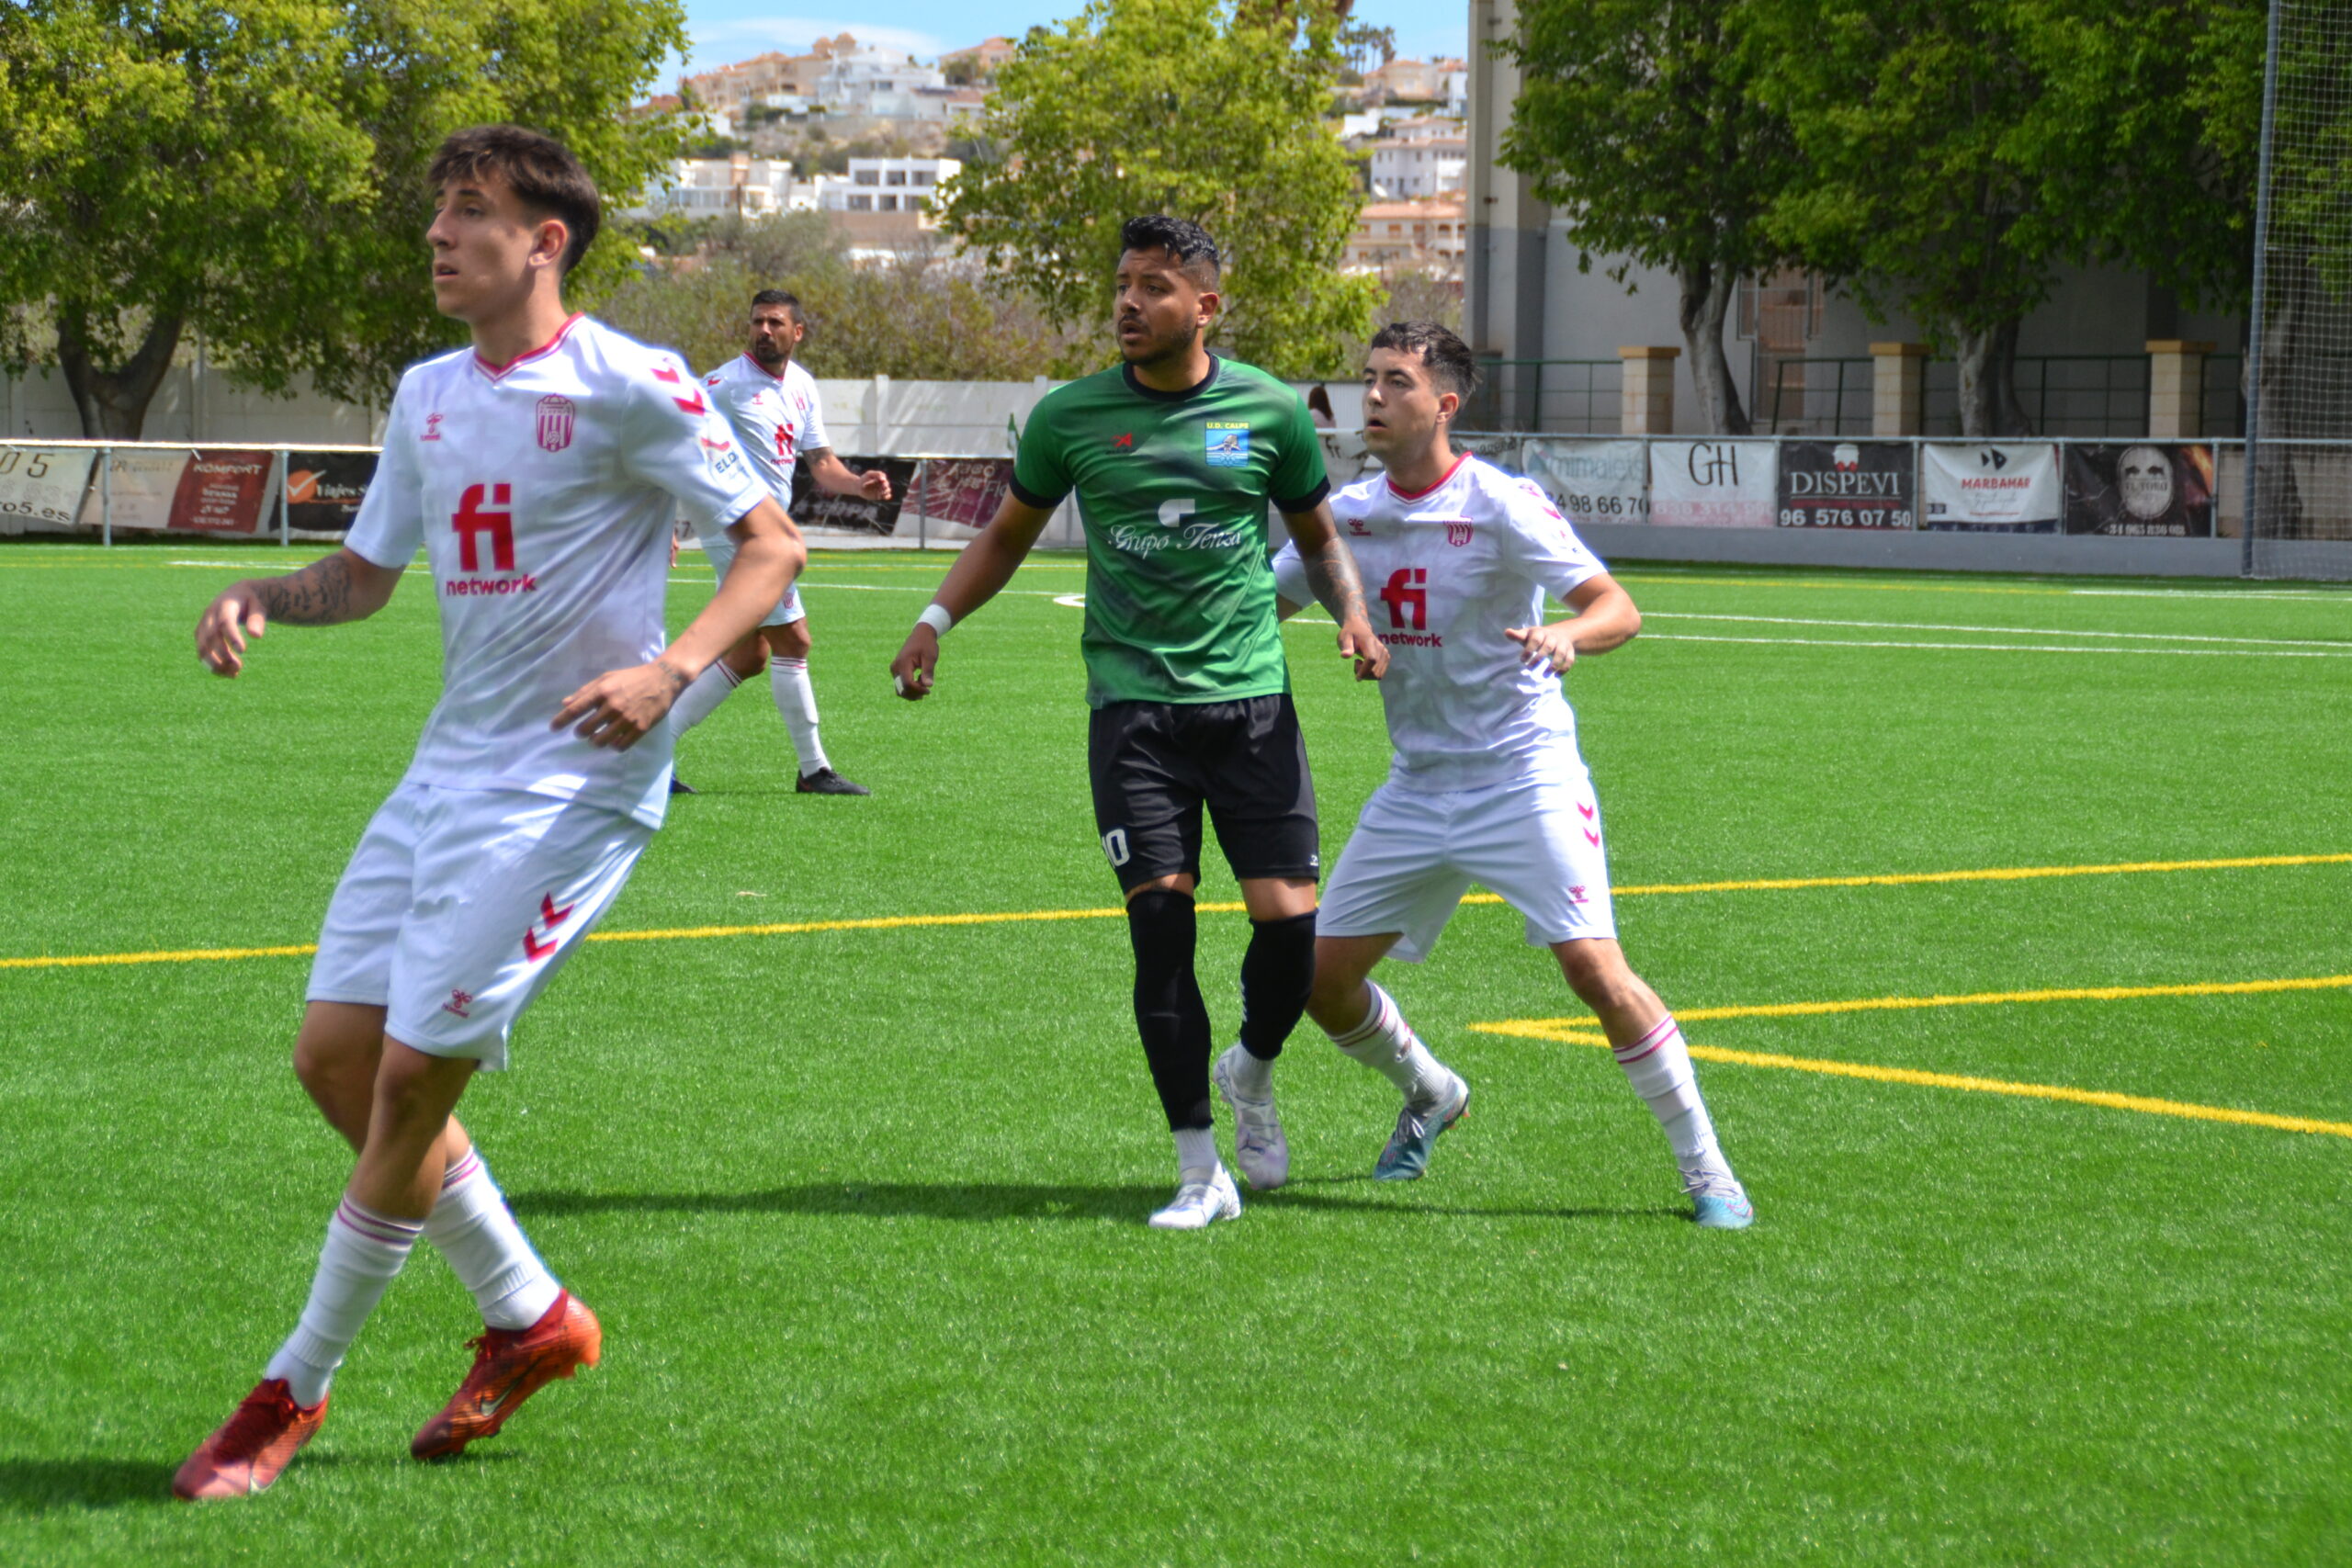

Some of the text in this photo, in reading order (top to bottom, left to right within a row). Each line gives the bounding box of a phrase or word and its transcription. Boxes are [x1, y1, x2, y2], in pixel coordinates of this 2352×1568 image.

[1689, 441, 1738, 486] GH
[1791, 470, 1902, 495] DISPEVI
[451, 483, 514, 572] fi
[1780, 509, 1807, 526] 96
[1815, 509, 1854, 526] 576
[1860, 510, 1885, 526] 07
[1891, 511, 1911, 527] 50
[1108, 523, 1242, 559] Grupo Tenza
[446, 573, 537, 596] network
[1380, 568, 1427, 631] fi
[1378, 631, 1443, 648] network
